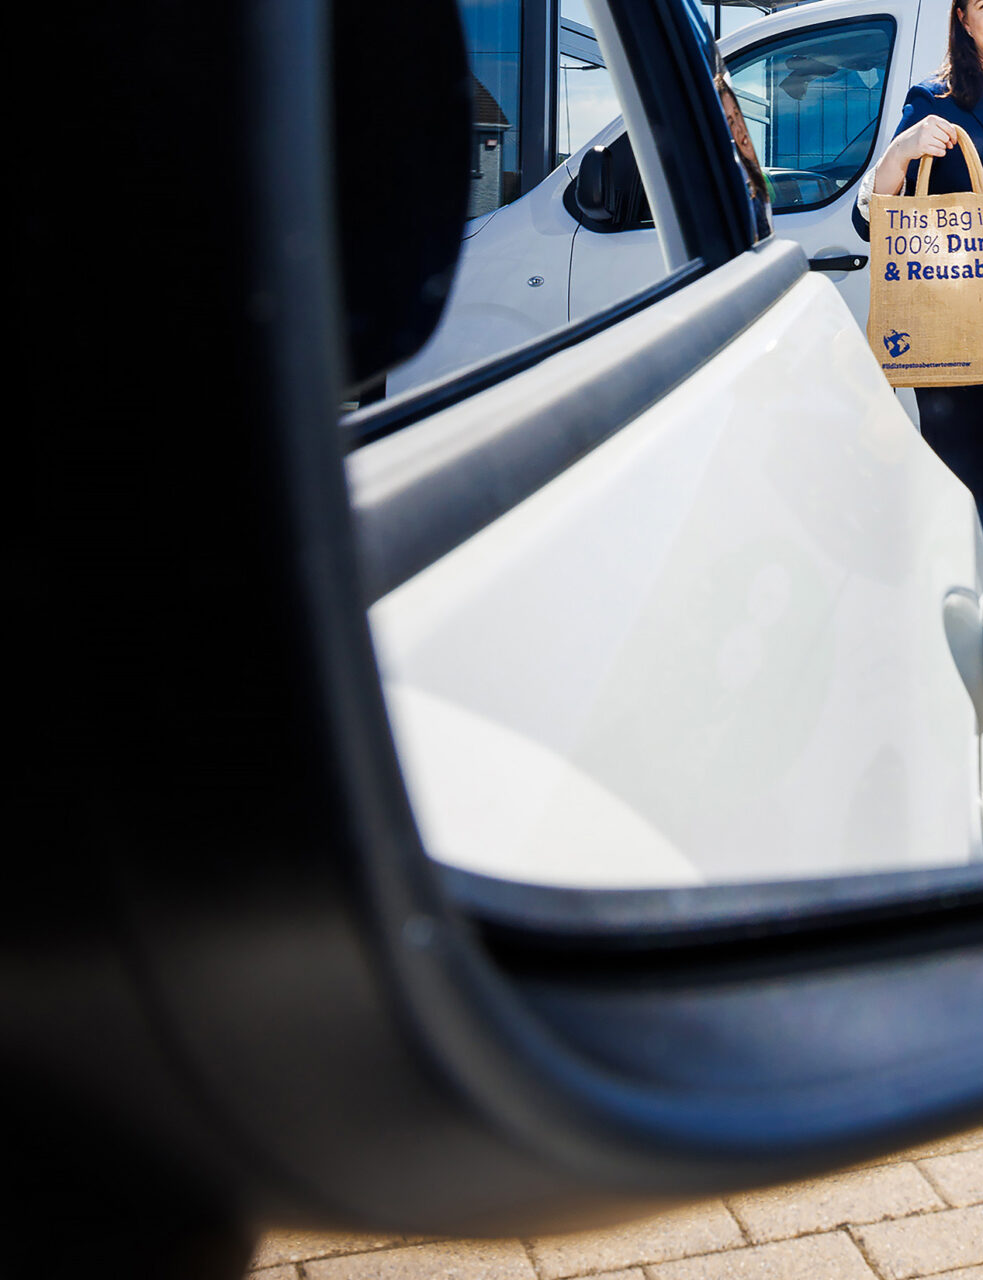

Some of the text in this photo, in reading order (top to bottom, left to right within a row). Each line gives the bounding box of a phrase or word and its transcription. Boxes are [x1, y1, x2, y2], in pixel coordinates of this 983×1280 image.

[886, 210, 928, 229] This
[936, 209, 972, 230] Bag
[885, 235, 940, 255] 100%
[884, 262, 900, 281] &
